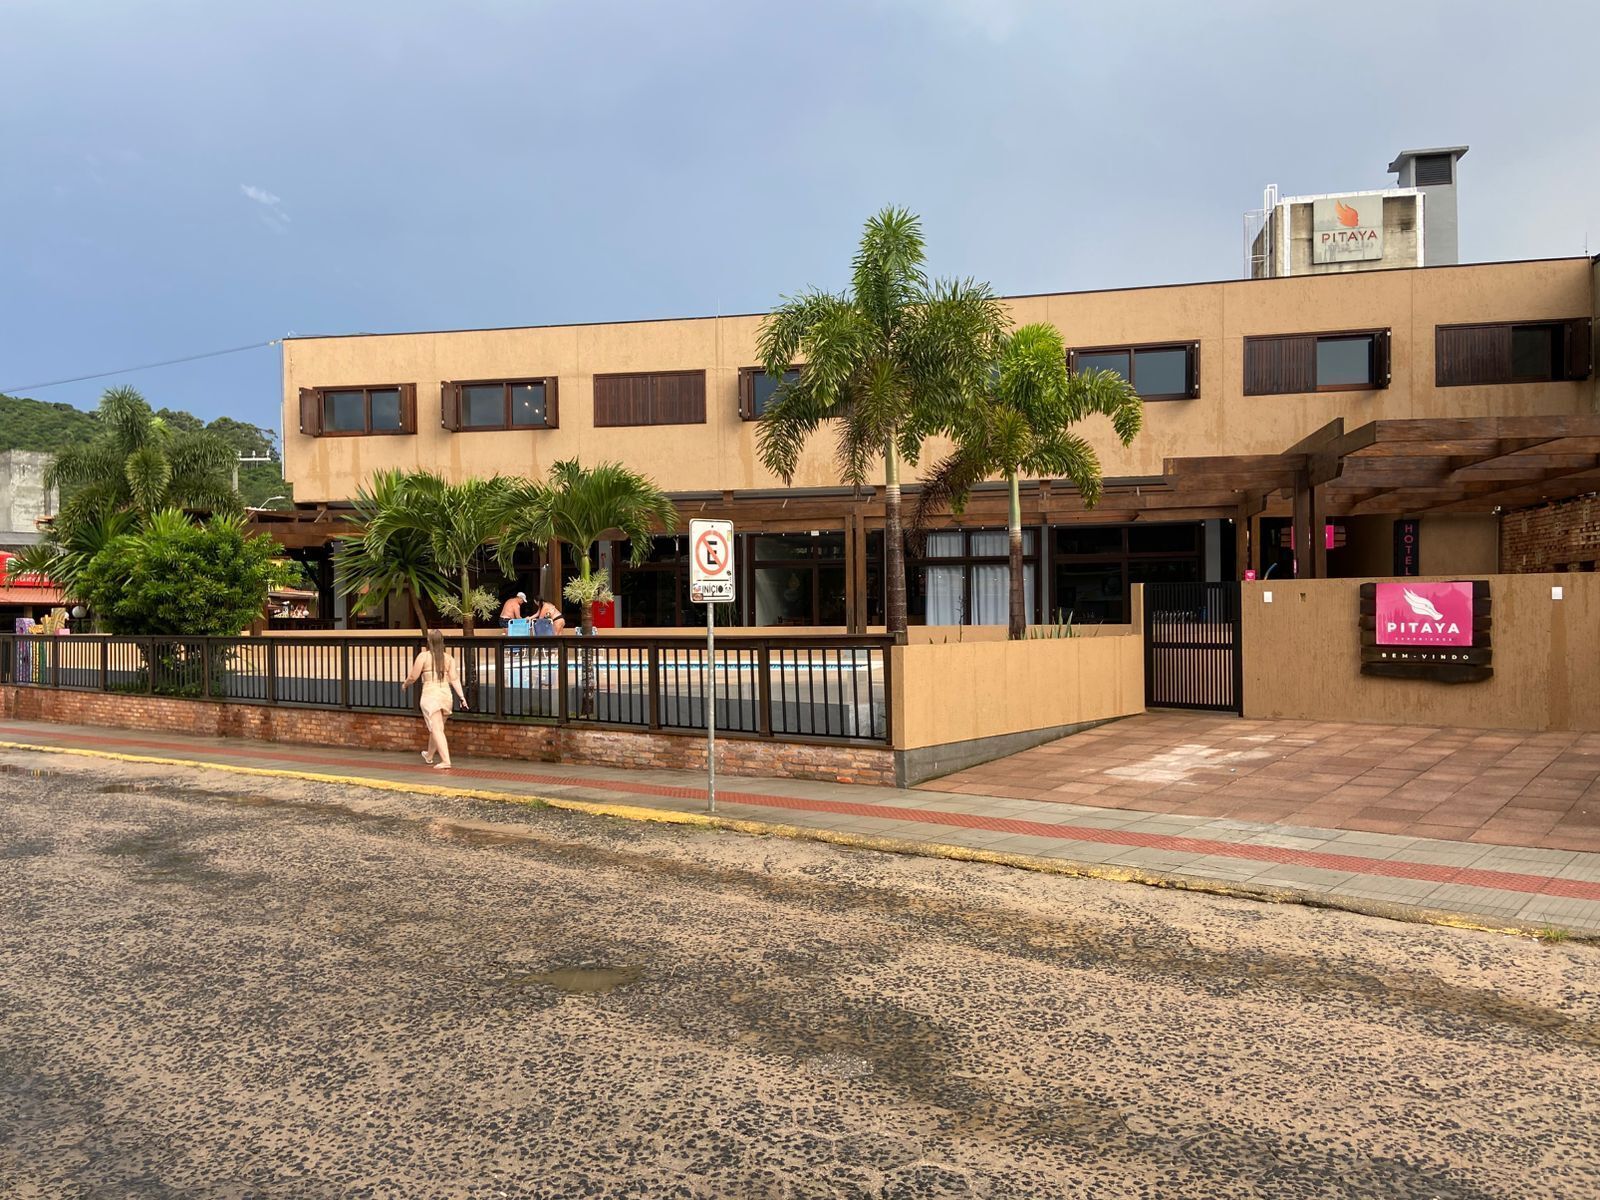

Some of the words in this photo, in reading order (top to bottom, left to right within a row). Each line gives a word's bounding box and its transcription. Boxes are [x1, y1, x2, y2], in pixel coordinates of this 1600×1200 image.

[1321, 230, 1378, 243] PITAYA
[1404, 524, 1413, 576] HOTEL
[1387, 622, 1460, 634] PITAYA
[1381, 652, 1469, 660] BEM-VINDO
